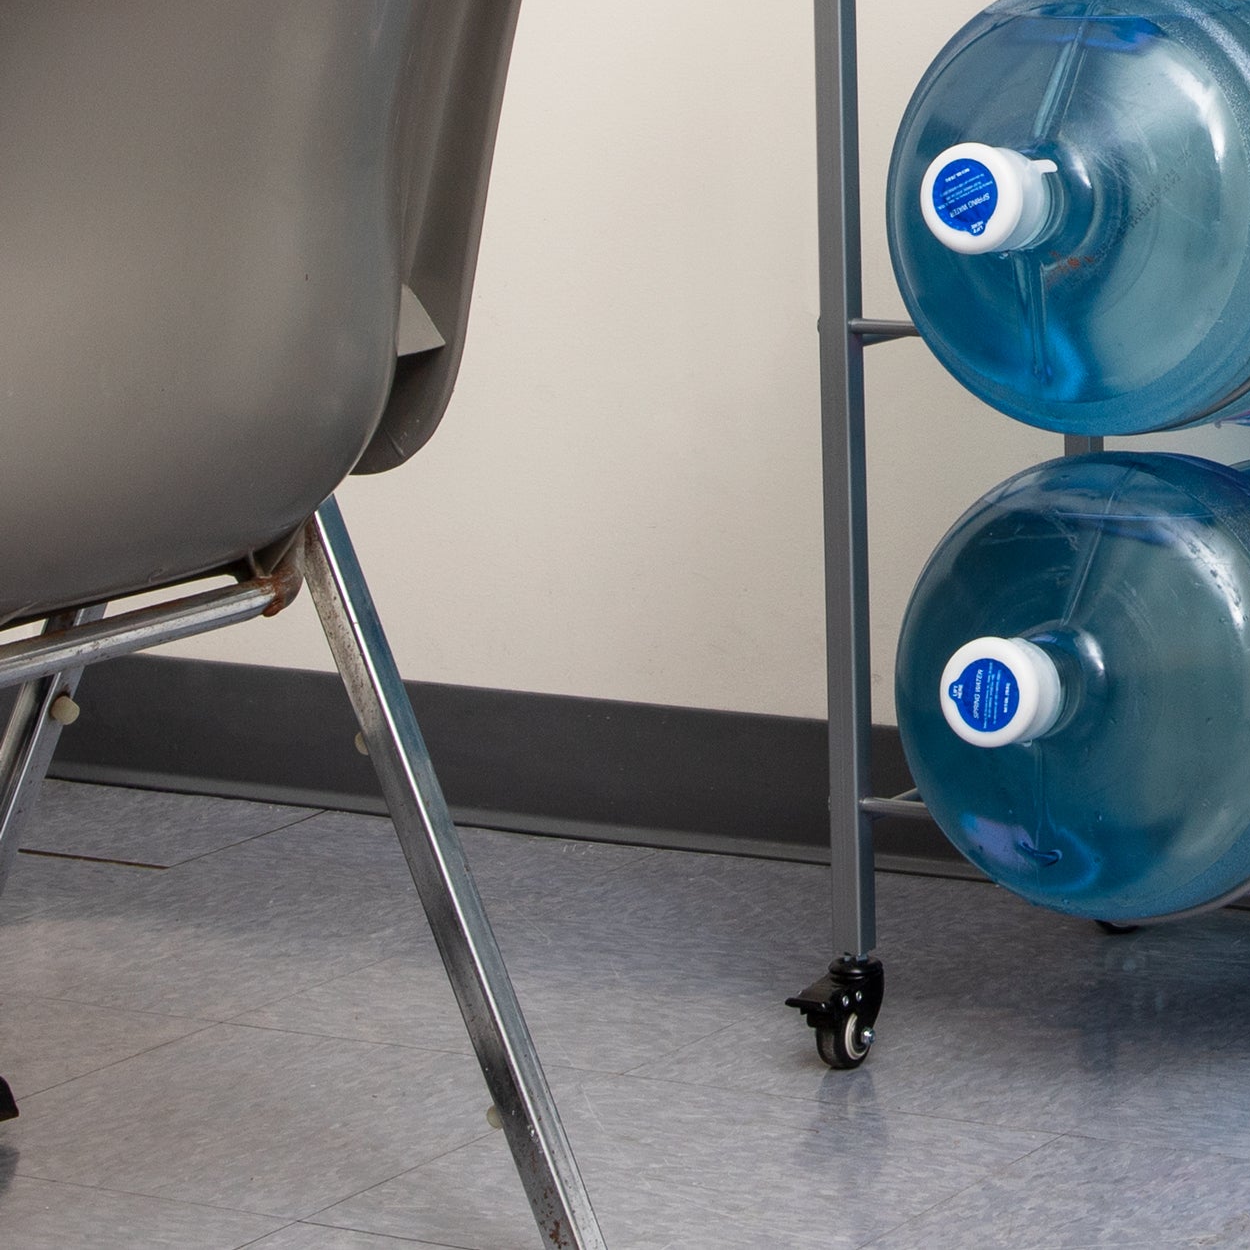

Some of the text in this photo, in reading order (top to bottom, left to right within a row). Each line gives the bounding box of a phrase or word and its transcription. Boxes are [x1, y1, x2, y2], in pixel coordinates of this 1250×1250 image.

[950, 192, 991, 218] SPRING WATER
[972, 669, 983, 719] SPRING WATER
